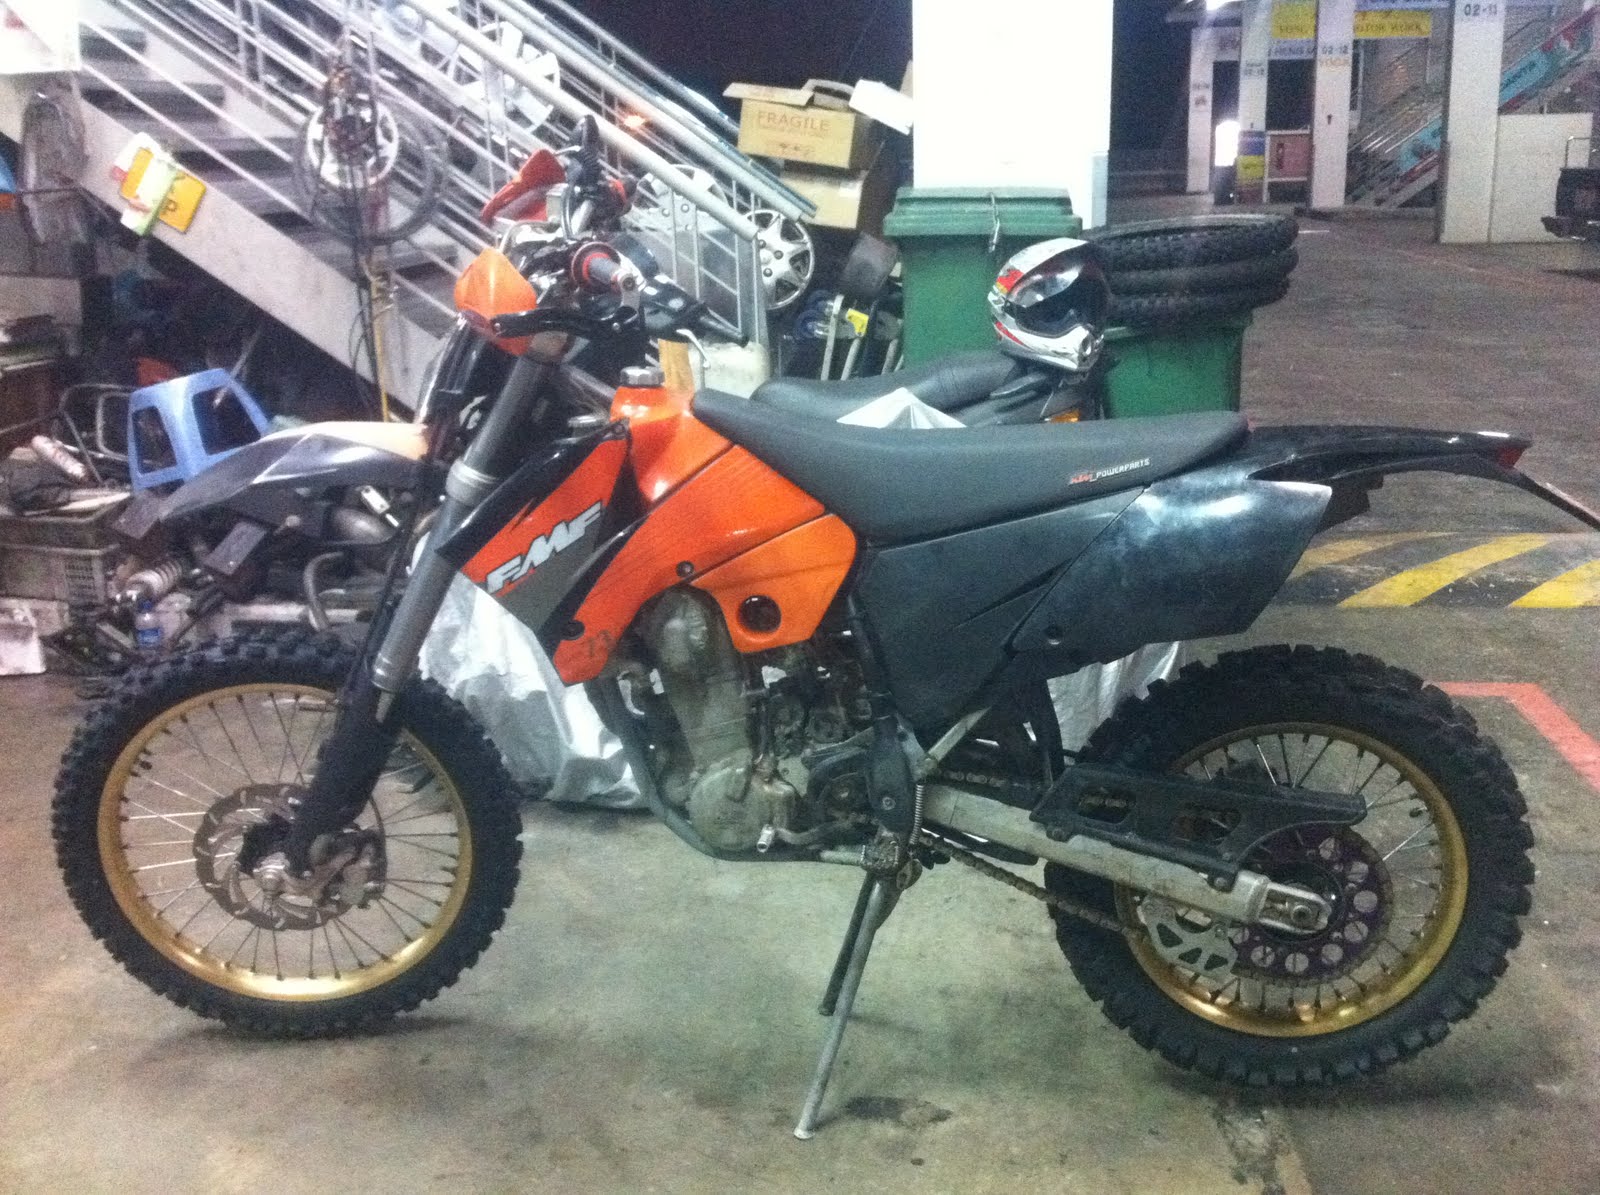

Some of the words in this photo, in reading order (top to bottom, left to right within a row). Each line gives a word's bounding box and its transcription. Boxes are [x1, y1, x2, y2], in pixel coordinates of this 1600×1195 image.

[757, 110, 832, 132] FRAGILE
[1096, 458, 1150, 478] POWERPARTS
[486, 501, 601, 594] FMF
